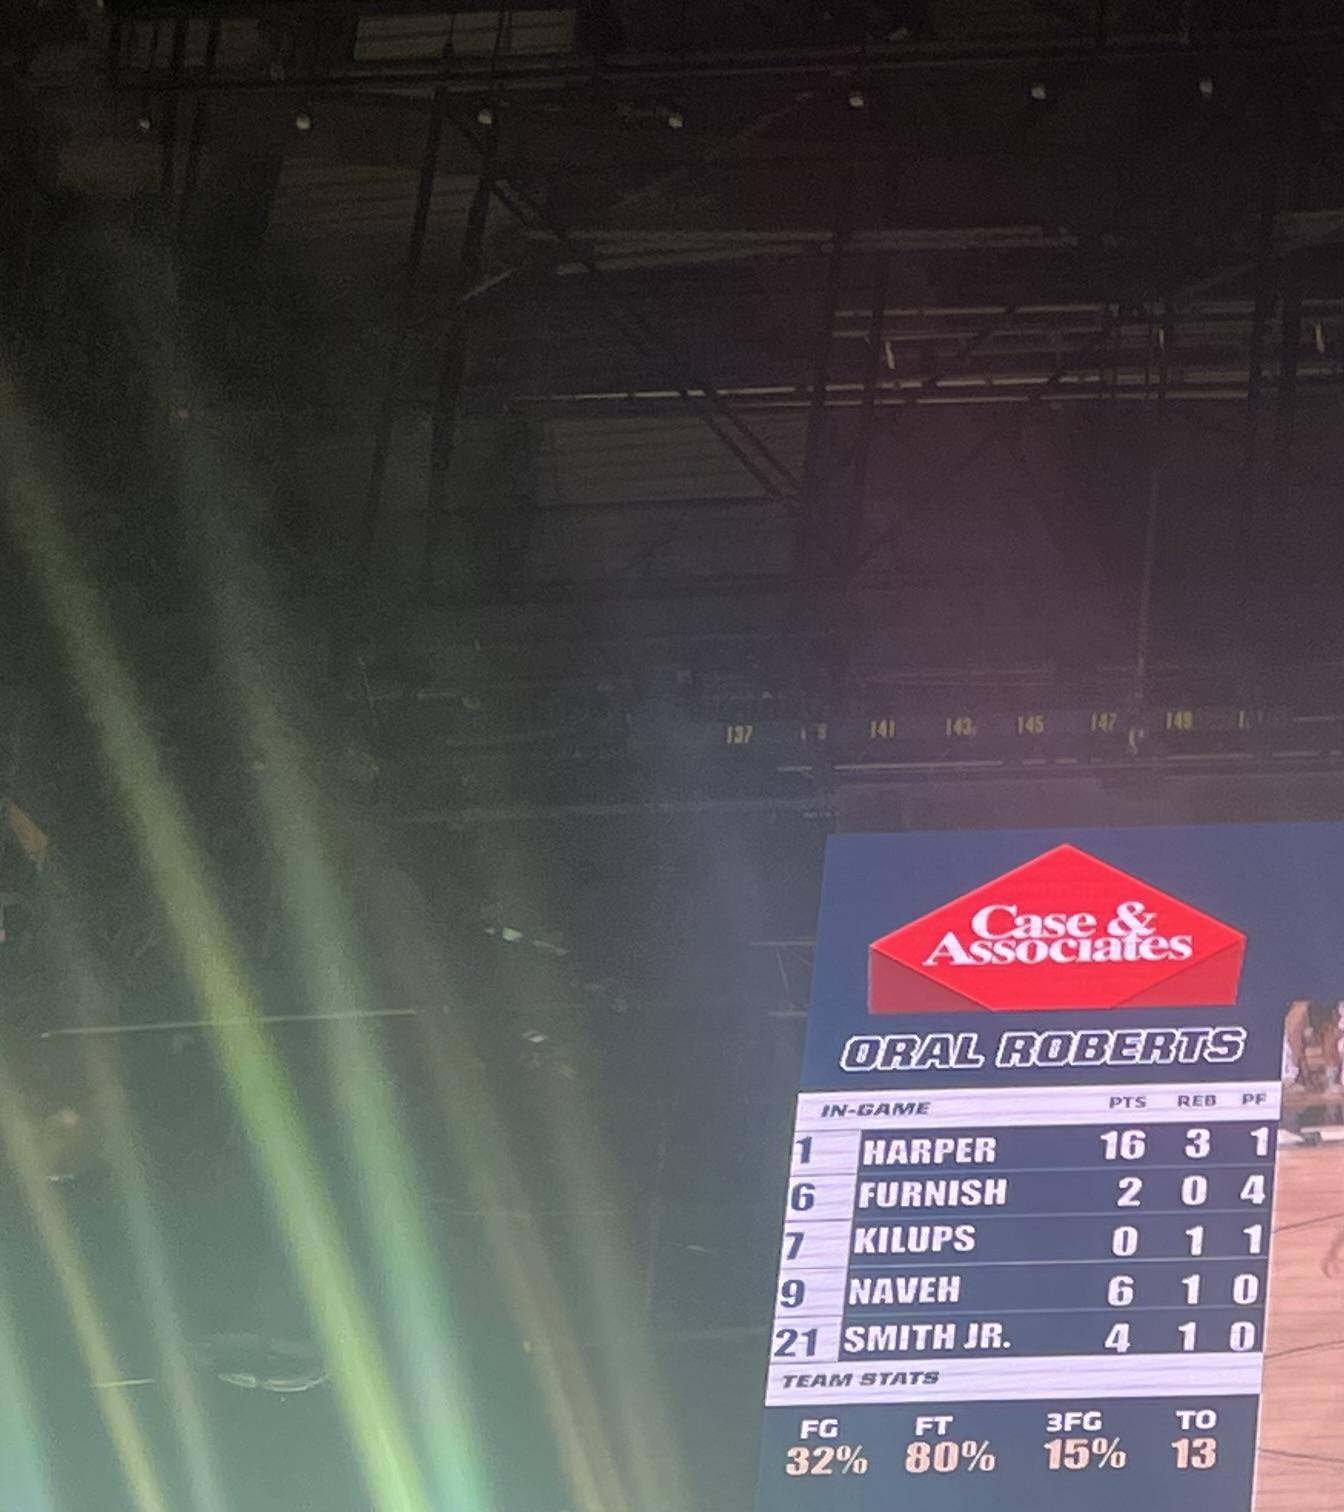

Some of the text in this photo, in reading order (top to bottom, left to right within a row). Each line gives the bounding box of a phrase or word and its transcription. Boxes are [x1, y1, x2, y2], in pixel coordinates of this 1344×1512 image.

[972, 901, 1156, 940] Case &
[922, 932, 1193, 966] Associates
[840, 1027, 1247, 1072] ORAL ROBERTS
[821, 1094, 1266, 1118] IN-GAME PTS REB PF
[795, 1126, 1269, 1165] 1 HARPER 16 3 1
[790, 1174, 1264, 1210] 6 FURNISH 2 0 4
[785, 1223, 1262, 1260] 7 KILUPS 0 1 1
[781, 1274, 1258, 1307] 9 NAVEH 6 1 0
[773, 1321, 1254, 1357] 21 SMITH JR. 4 1 0
[782, 1371, 940, 1388] TEAM STATS
[800, 1410, 1216, 1439] FG FT 3FG TO
[785, 1437, 1216, 1476] 32% 80% 15% 13
